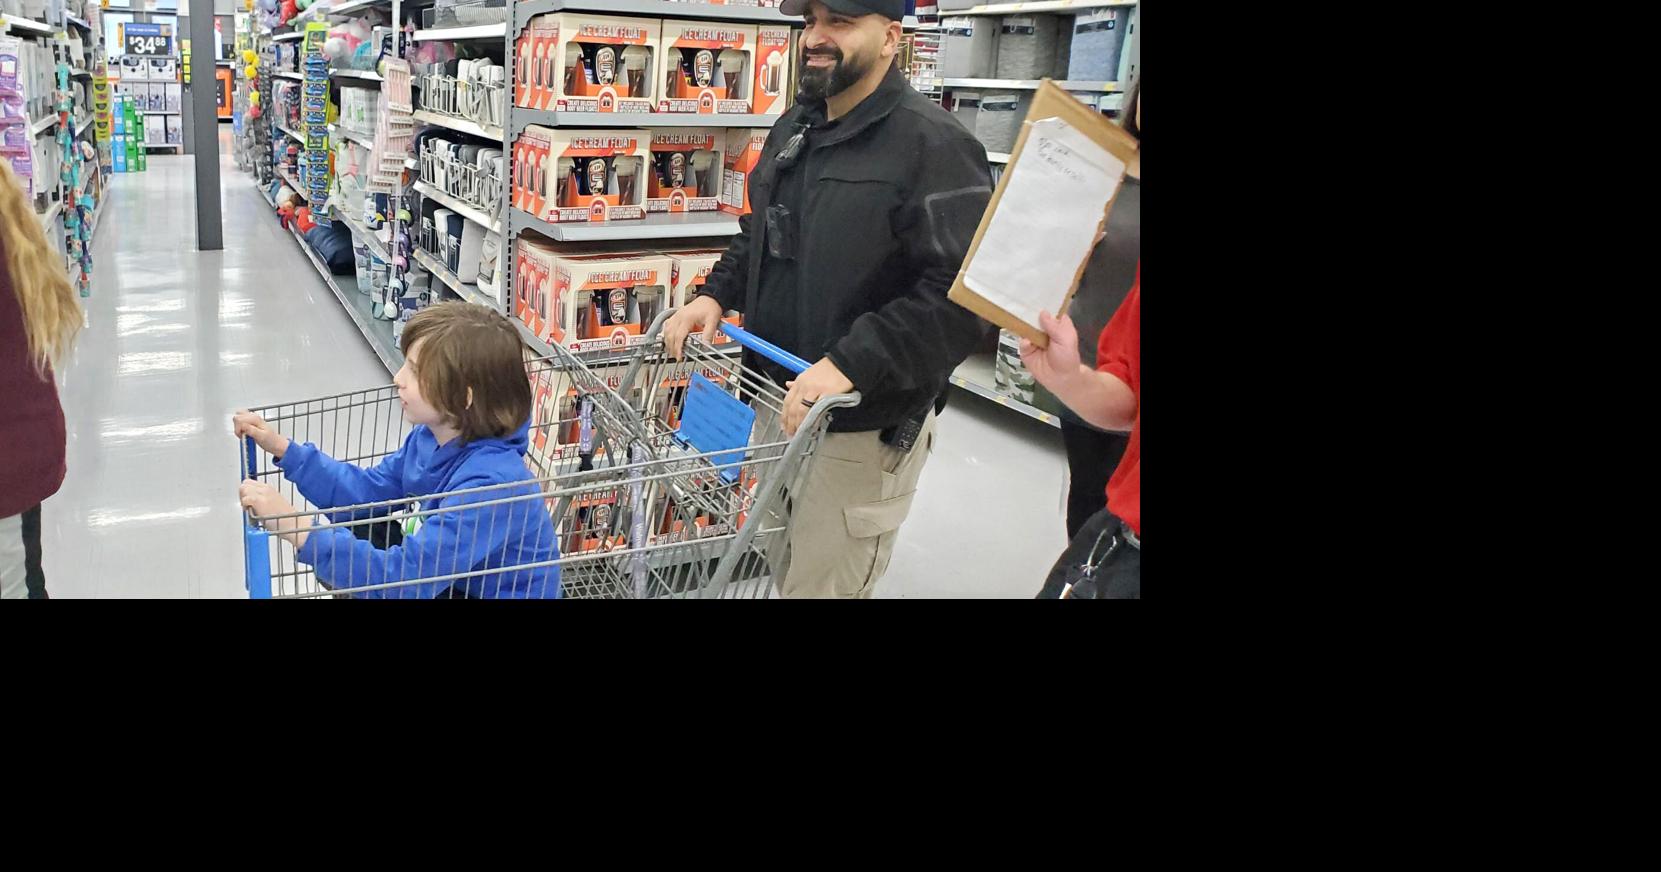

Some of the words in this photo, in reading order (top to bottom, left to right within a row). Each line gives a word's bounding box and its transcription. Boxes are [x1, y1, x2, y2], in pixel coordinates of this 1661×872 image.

[594, 25, 618, 38] CREAM
[620, 27, 641, 39] FLOAT
[681, 27, 694, 40] ICE
[695, 28, 718, 41] CREAM
[720, 31, 739, 42] FLOAT
[571, 136, 584, 148] ICE
[585, 136, 608, 149] CREAM
[611, 137, 631, 149] FLOAT
[653, 134, 665, 144] ICE
[666, 134, 689, 144] CREAM
[691, 134, 709, 144] FLOAT
